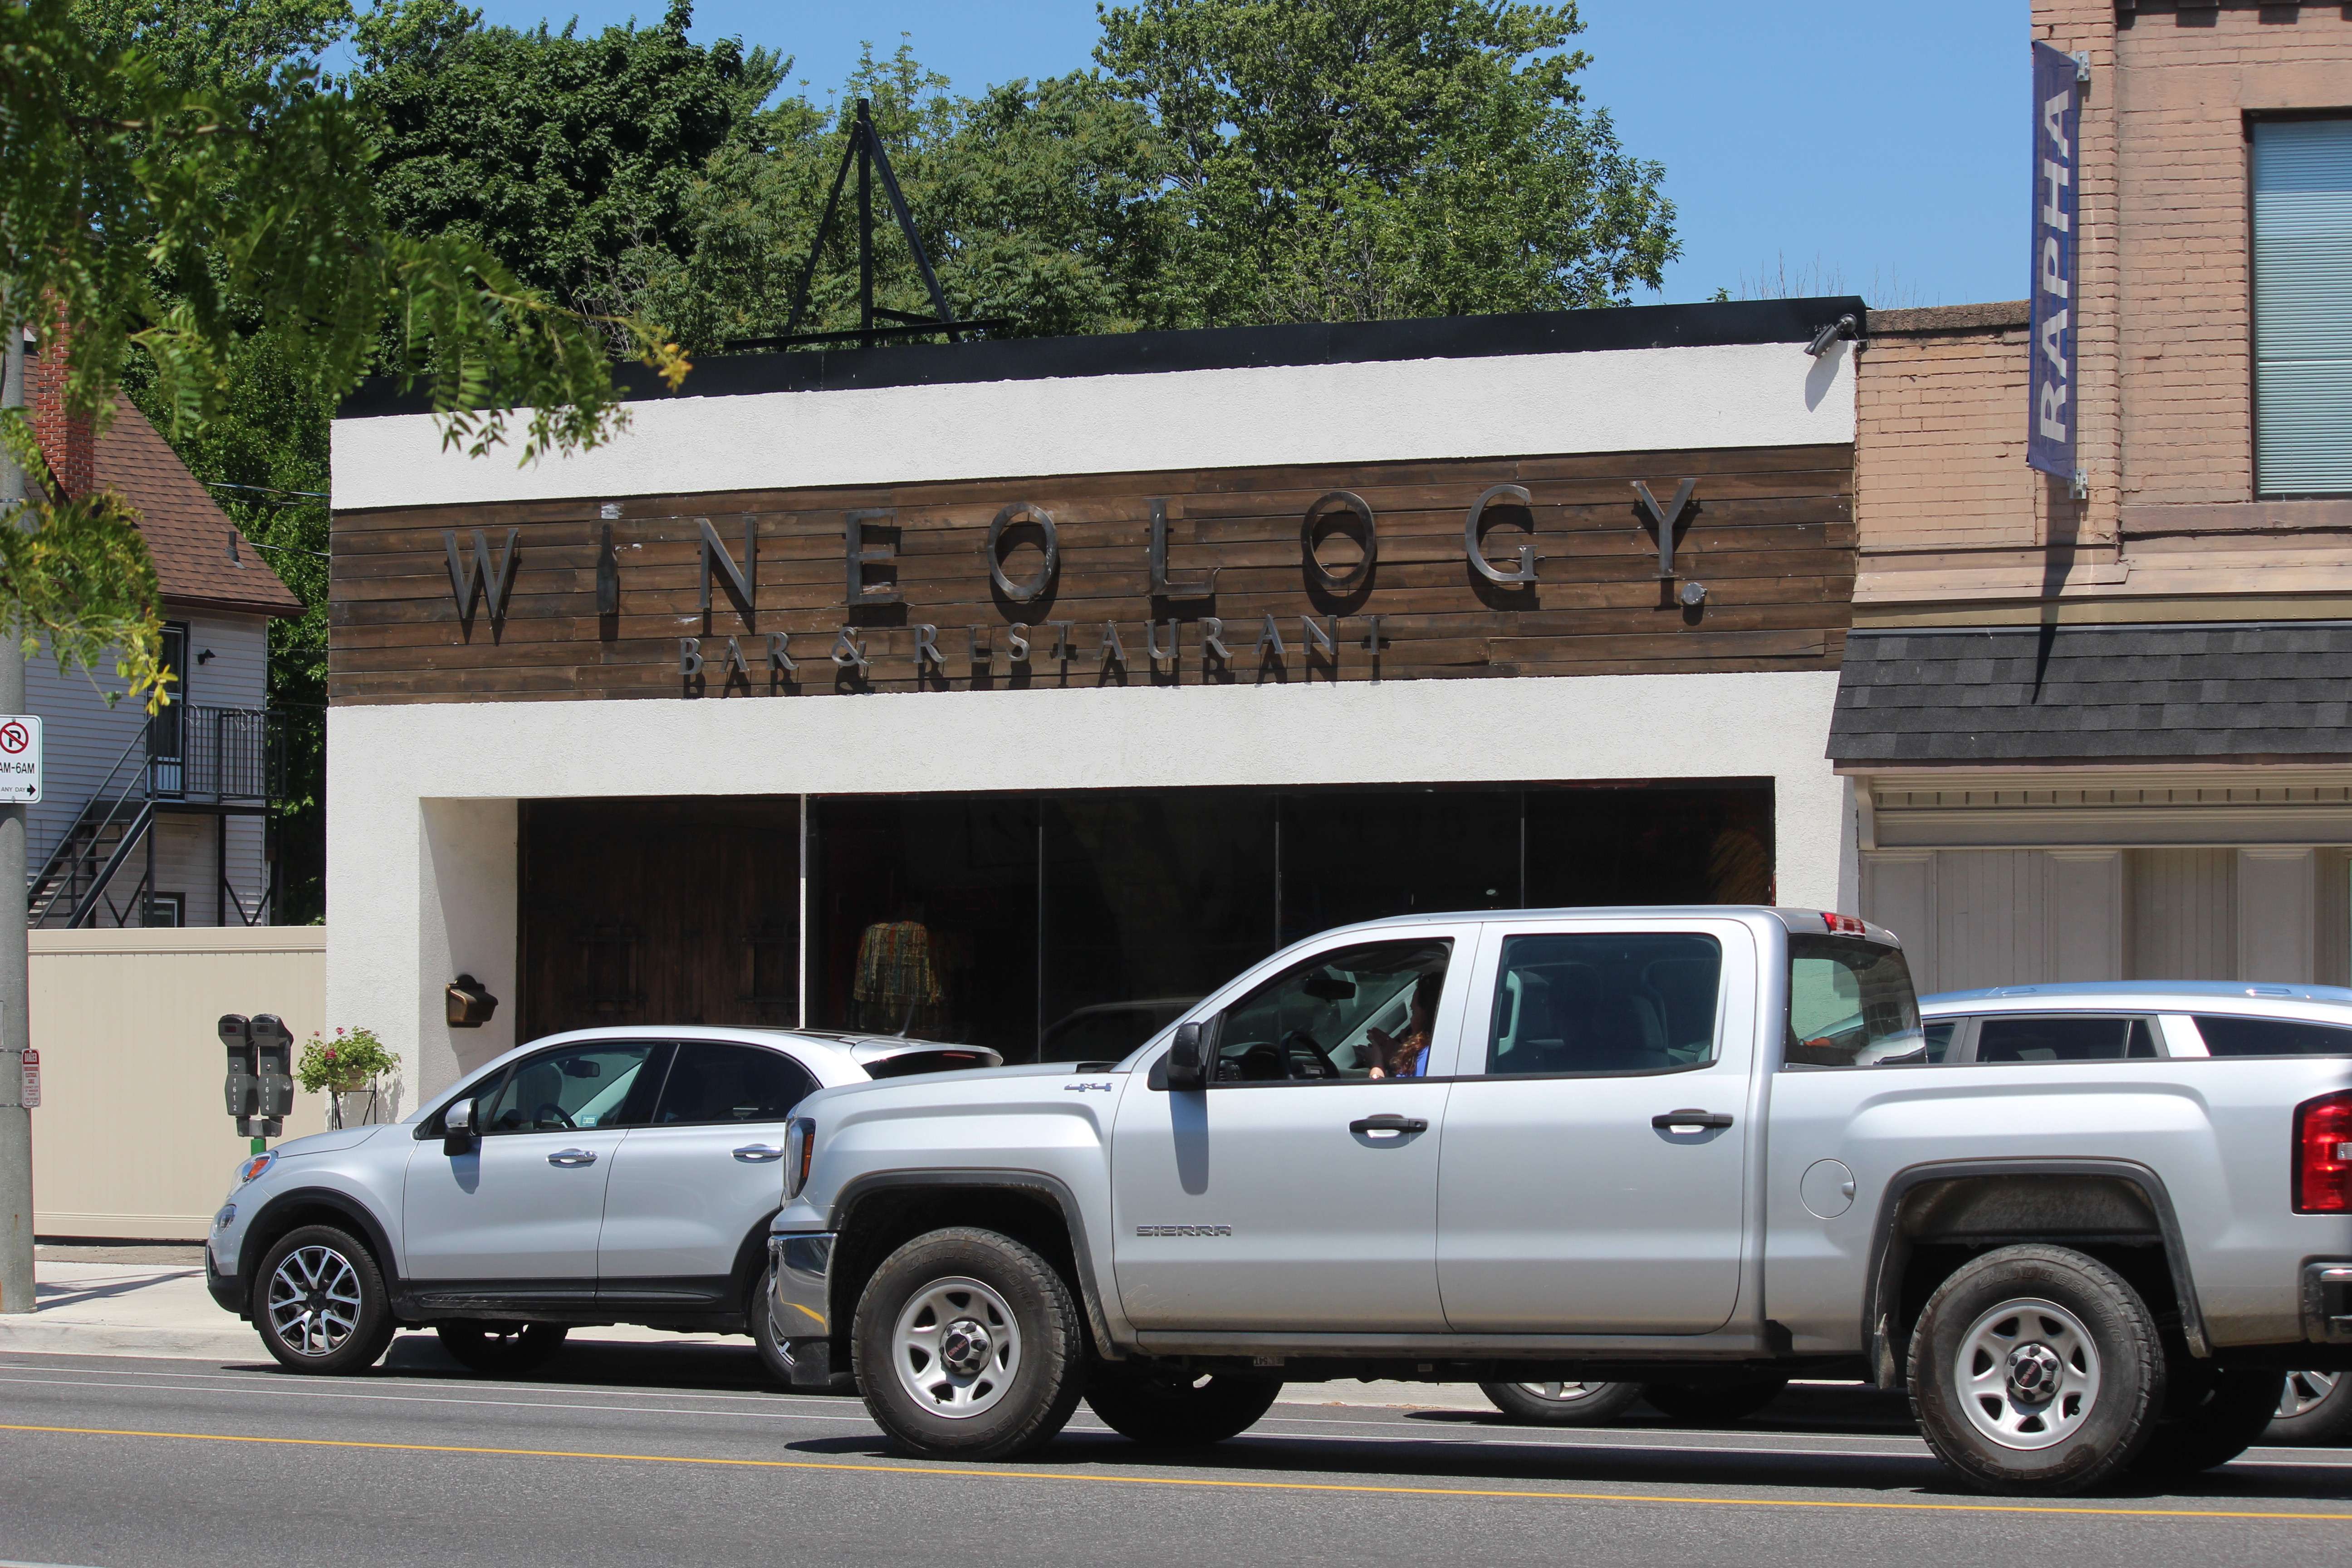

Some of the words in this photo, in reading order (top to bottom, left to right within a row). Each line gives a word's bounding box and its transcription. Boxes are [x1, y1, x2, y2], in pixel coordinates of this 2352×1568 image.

[2040, 89, 2069, 443] RAPHA
[679, 631, 799, 676] BAR
[830, 626, 872, 667] &
[913, 614, 1389, 665] RESTAURANT
[1137, 1225, 1231, 1236] SIERRA
[948, 1339, 967, 1356] GMC
